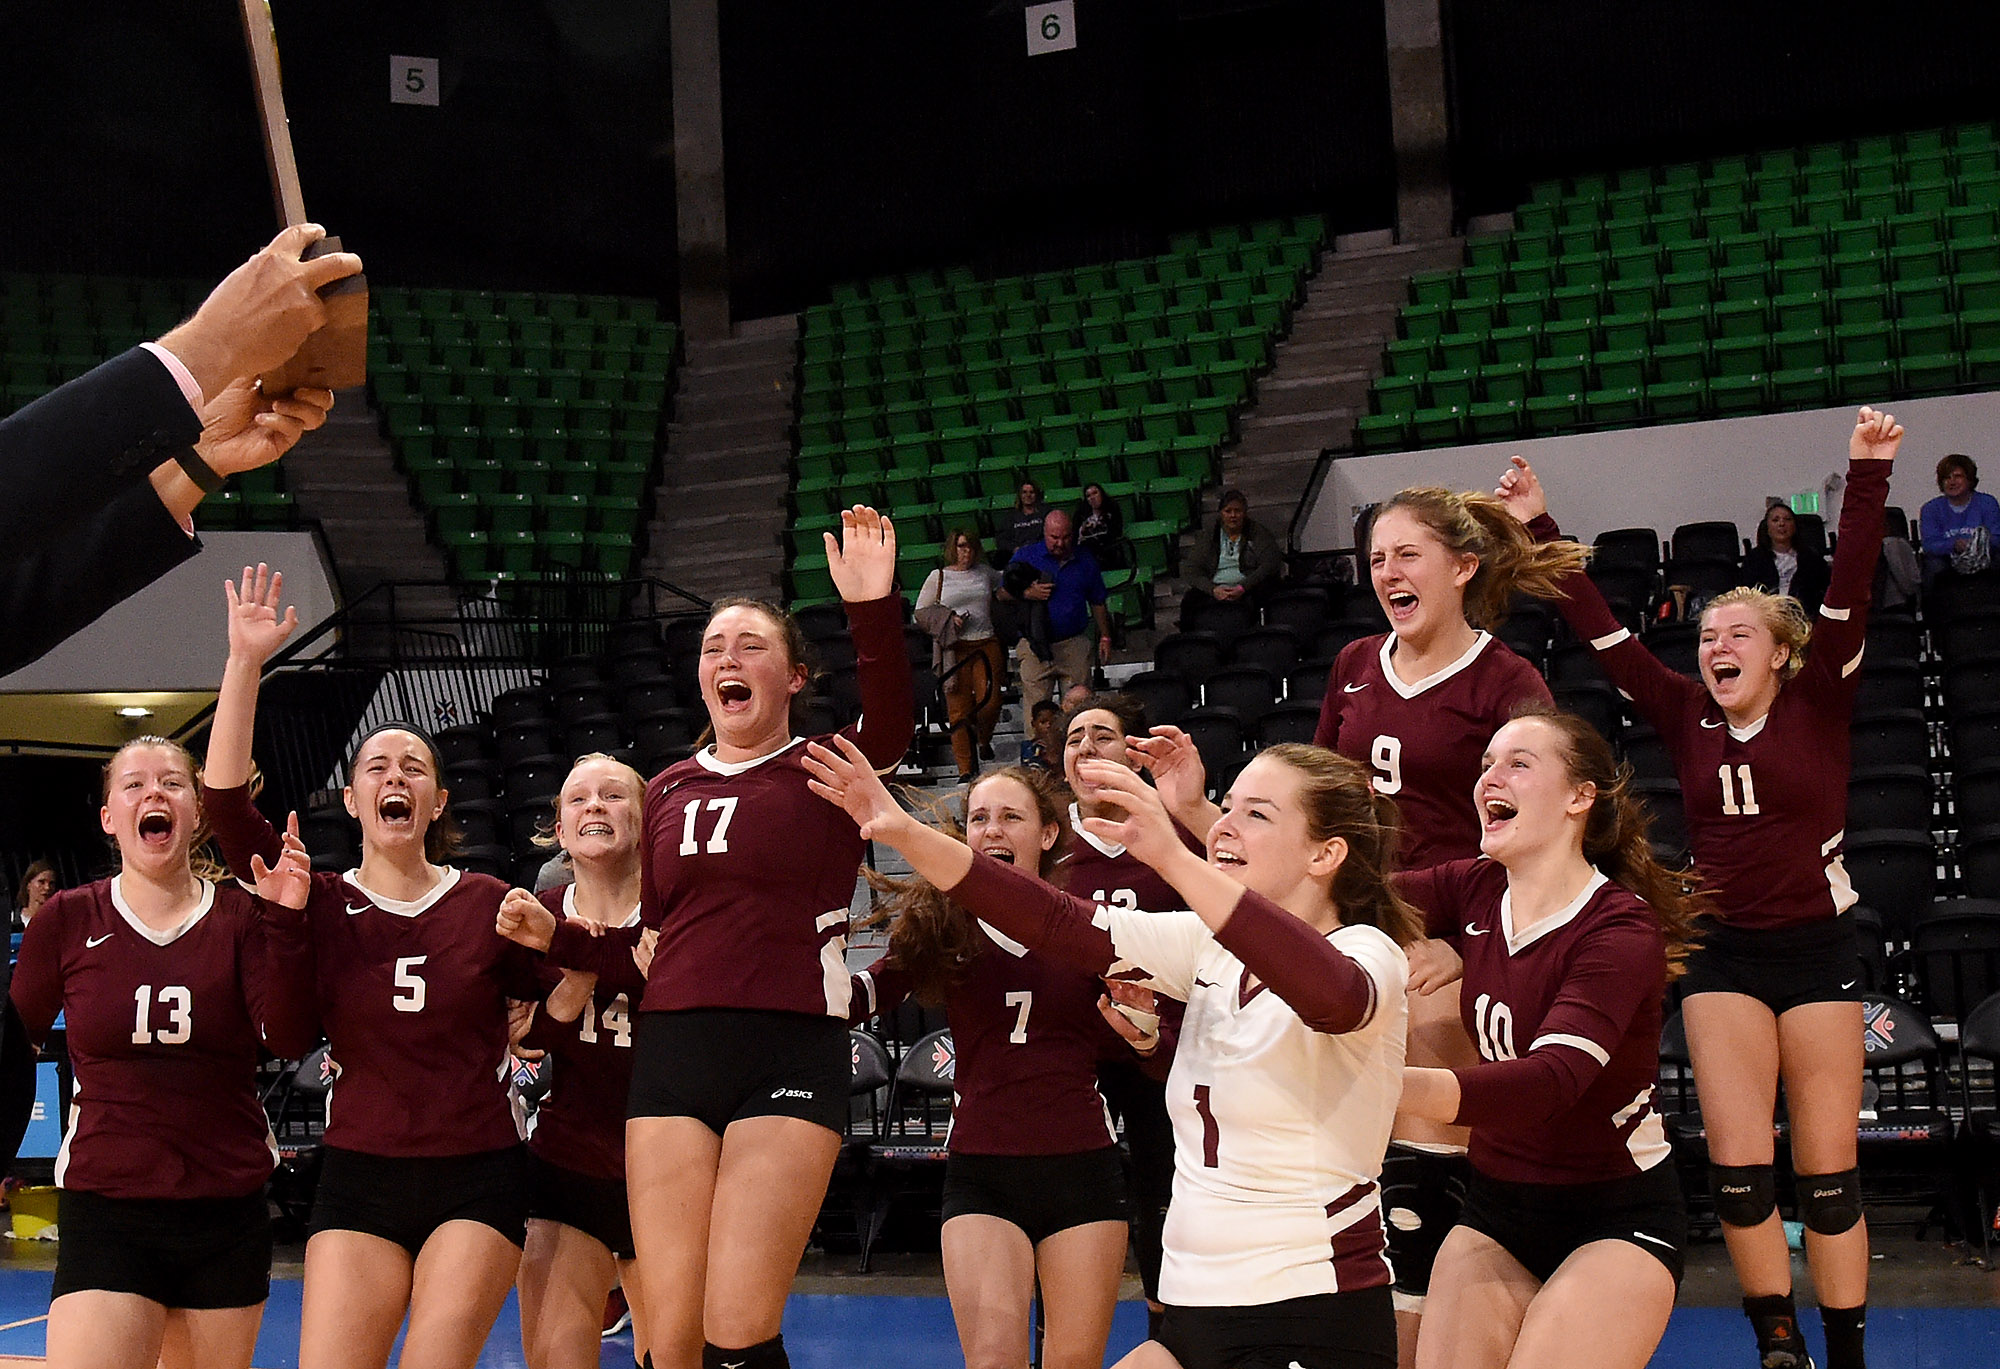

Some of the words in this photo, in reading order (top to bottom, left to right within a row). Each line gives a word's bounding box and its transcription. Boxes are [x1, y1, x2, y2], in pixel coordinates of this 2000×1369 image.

[1041, 14, 1060, 40] 6
[406, 68, 424, 93] 5
[1371, 734, 1402, 796] 9
[1718, 764, 1760, 815] 11
[679, 796, 739, 857] 17
[392, 955, 427, 1012] 5
[131, 984, 192, 1044] 13
[579, 990, 631, 1047] 14
[1005, 991, 1032, 1044] 7
[1474, 993, 1517, 1062] 10
[784, 1089, 814, 1099] asics
[1193, 1084, 1220, 1168] 1
